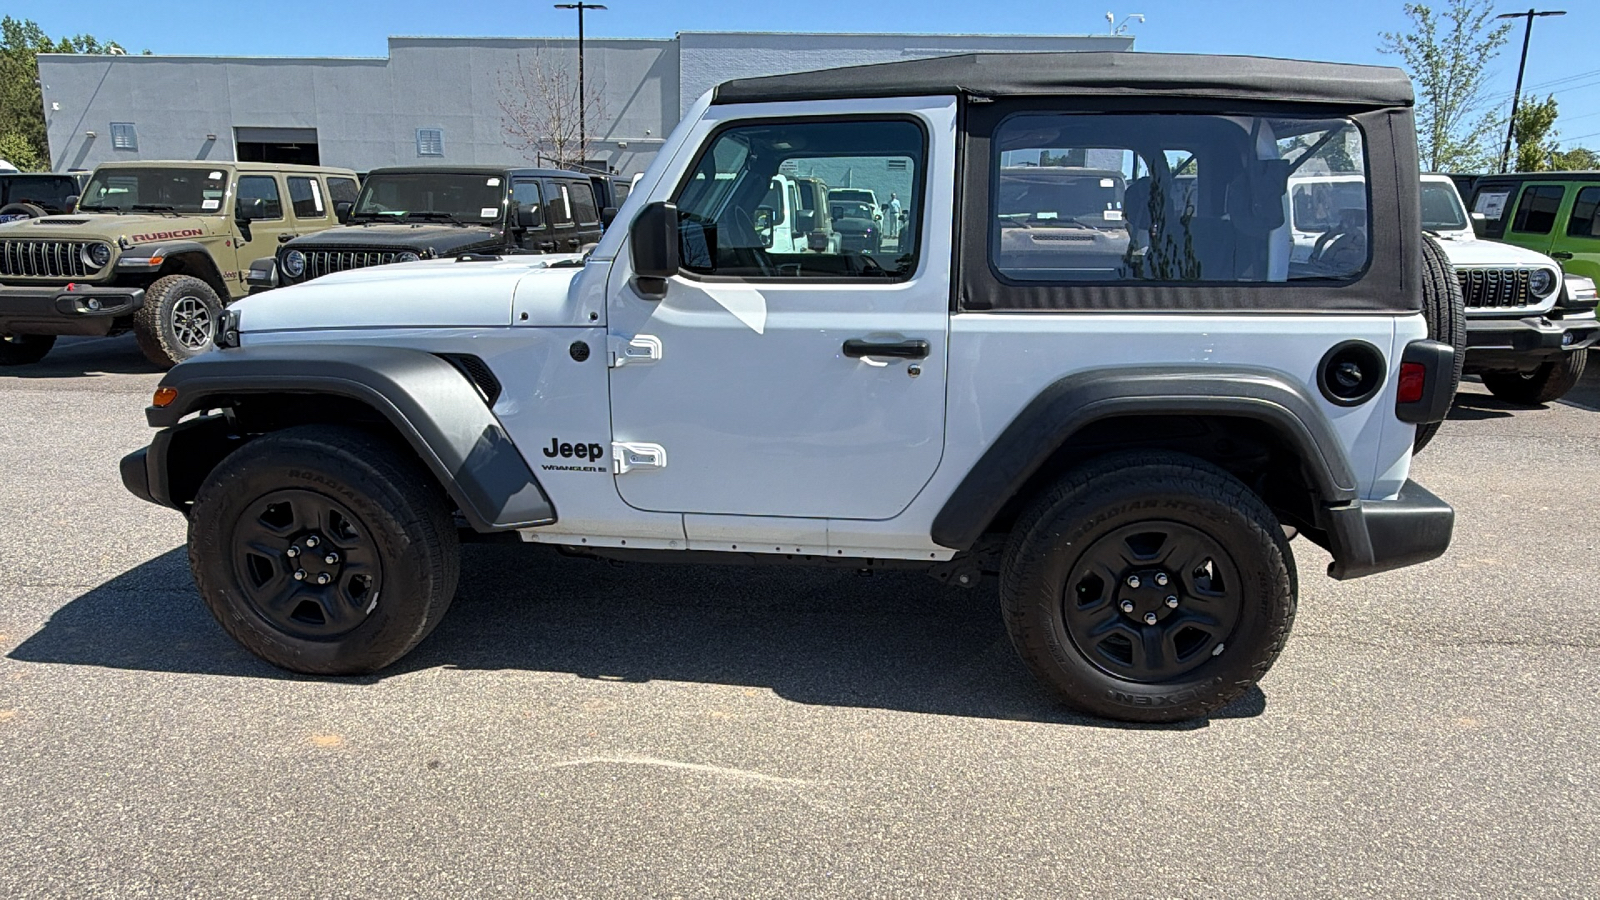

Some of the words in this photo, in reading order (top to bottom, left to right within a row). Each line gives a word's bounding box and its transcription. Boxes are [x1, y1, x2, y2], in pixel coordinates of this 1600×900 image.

[132, 229, 204, 242] RUBICON
[543, 438, 604, 462] Jeep
[541, 464, 597, 472] WRANGLER
[1114, 681, 1211, 706] NEXEN
